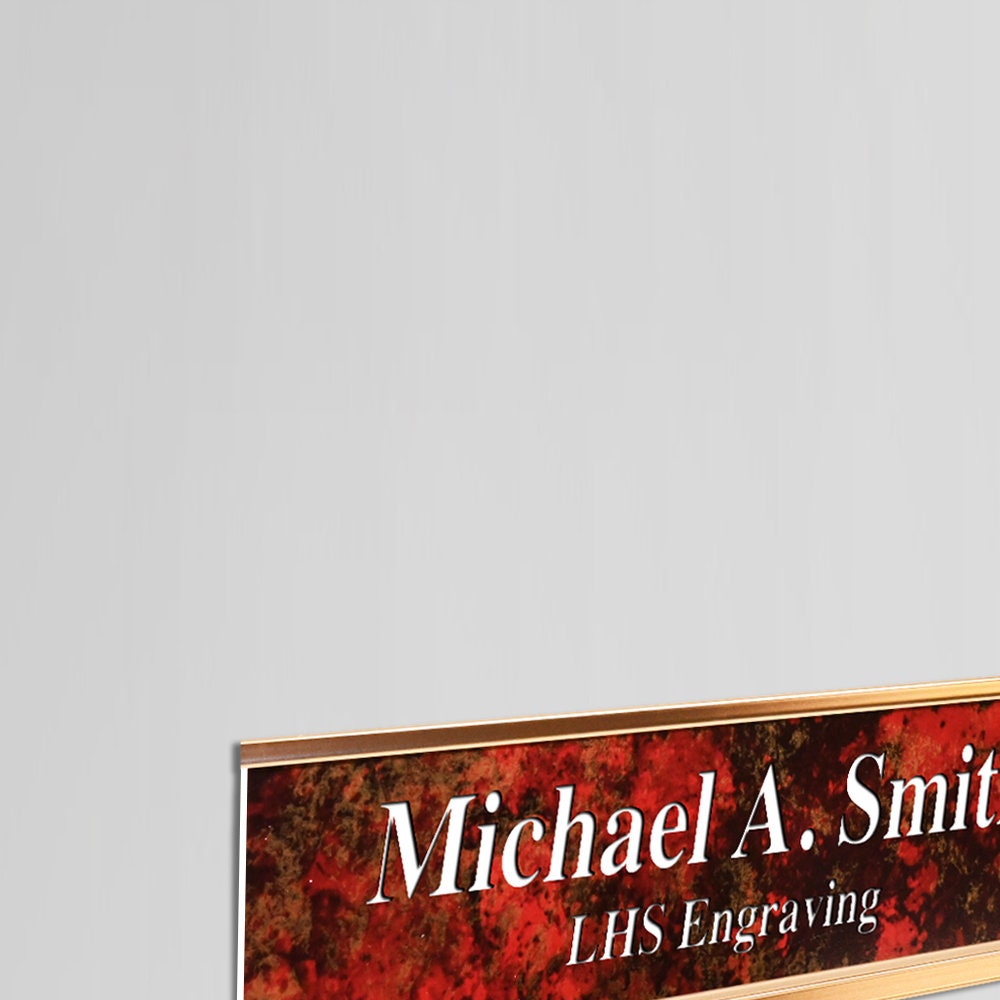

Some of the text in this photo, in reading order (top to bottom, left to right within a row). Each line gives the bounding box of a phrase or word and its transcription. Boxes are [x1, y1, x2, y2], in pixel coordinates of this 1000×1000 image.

[367, 772, 715, 906] Michael
[730, 765, 815, 859] A.
[566, 880, 881, 967] LHS Engraving
